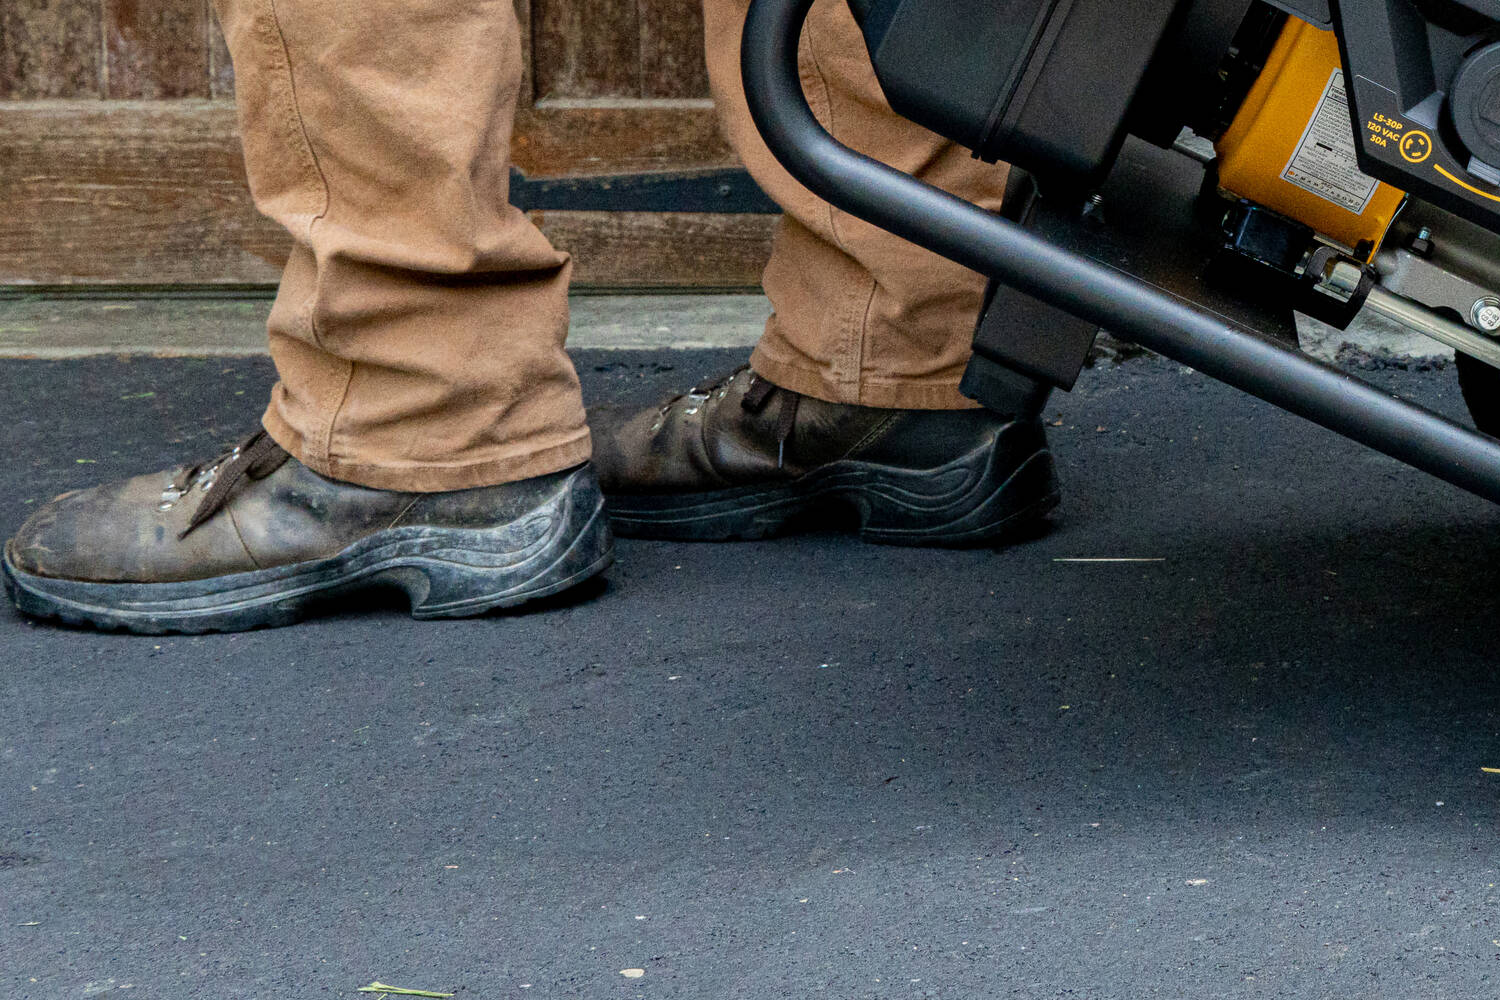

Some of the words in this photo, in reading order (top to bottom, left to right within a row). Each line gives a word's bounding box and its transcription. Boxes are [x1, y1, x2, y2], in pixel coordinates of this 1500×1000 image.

[1366, 121, 1381, 133] 120
[1381, 128, 1400, 141] VAC
[1373, 112, 1403, 131] L5-30P
[1369, 134, 1388, 147] 30A
